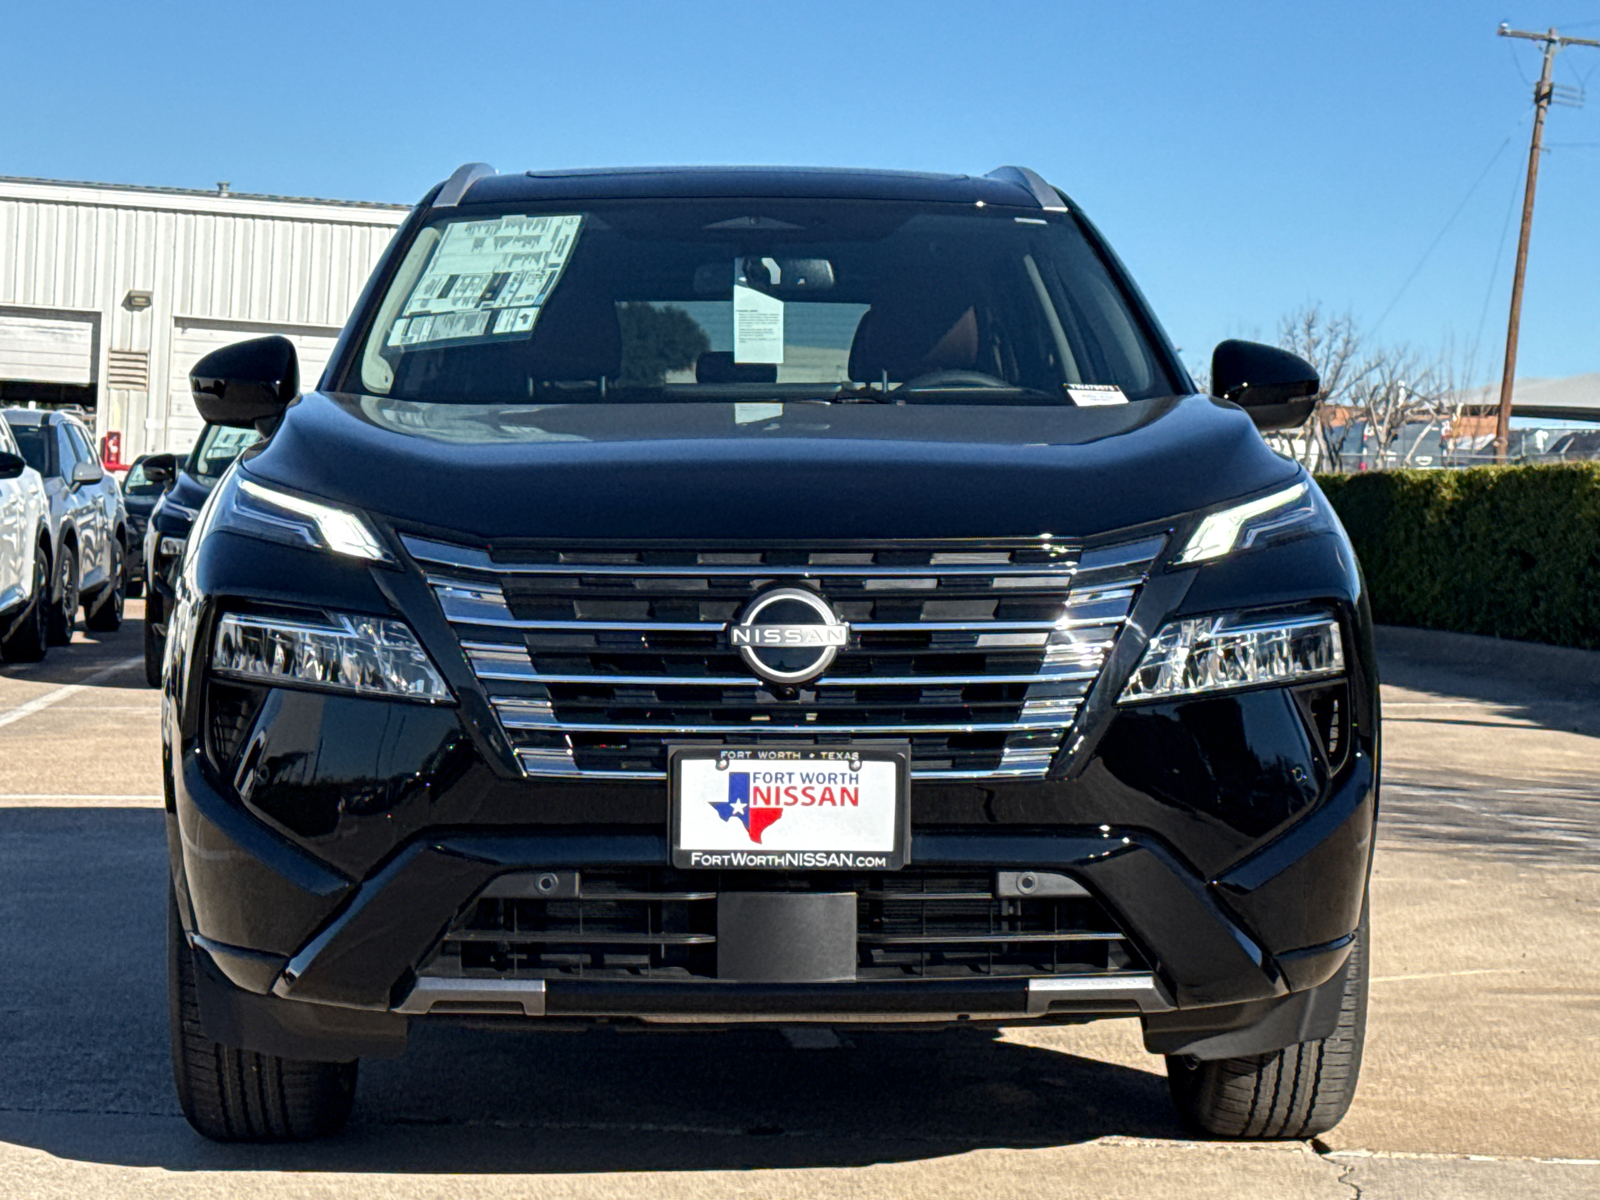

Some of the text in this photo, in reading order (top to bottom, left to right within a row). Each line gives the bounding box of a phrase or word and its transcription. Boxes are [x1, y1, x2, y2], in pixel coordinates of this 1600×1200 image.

[733, 628, 843, 643] NISSAN
[720, 751, 859, 761] FORT WORTH TEXAS
[753, 772, 858, 785] FORT WORTH
[753, 786, 858, 807] NISSAN
